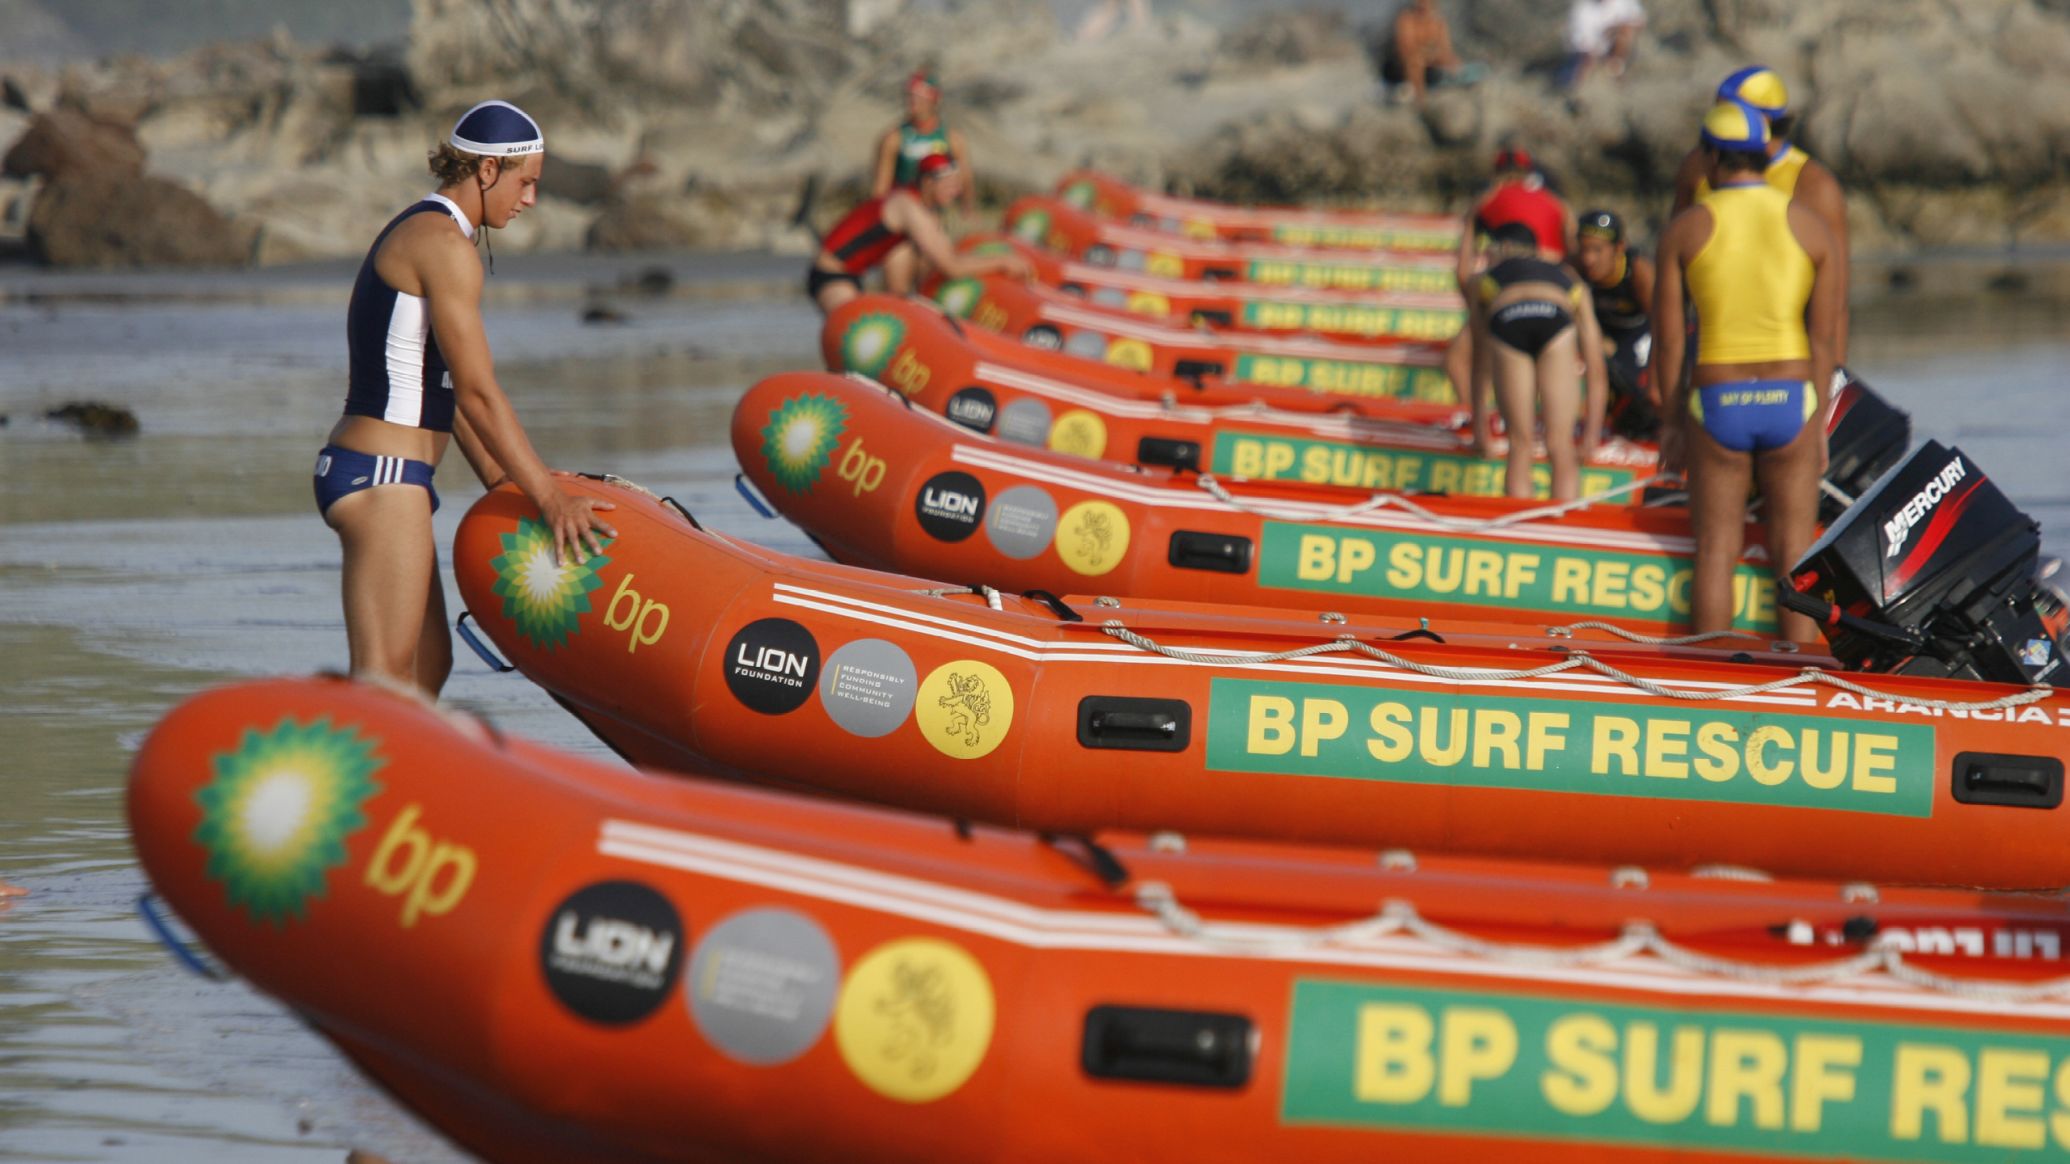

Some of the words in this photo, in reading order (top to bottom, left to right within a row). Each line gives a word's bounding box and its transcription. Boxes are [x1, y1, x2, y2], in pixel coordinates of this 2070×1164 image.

[506, 145, 533, 154] SURF
[837, 435, 887, 498] bp
[1232, 438, 1295, 480] BP
[1303, 446, 1420, 490] SURF
[923, 486, 979, 516] LION
[1884, 456, 1967, 558] MERCURY
[1297, 534, 1376, 584] BP
[1386, 543, 1540, 599] SURF
[602, 572, 670, 654] bp
[734, 666, 803, 688] FOUNDATION
[737, 643, 809, 678] LION
[840, 674, 882, 688] FUNDING
[842, 665, 905, 684] RESPONSIBLY
[839, 681, 894, 699] COMMUNITY
[1246, 695, 1349, 757] BP
[1367, 702, 1572, 770] SURF
[1591, 715, 1899, 793] RESCUE
[363, 801, 478, 929] bp
[554, 911, 675, 973] LION
[1353, 1002, 1519, 1107] BP
[1540, 1013, 1864, 1132] SURF
